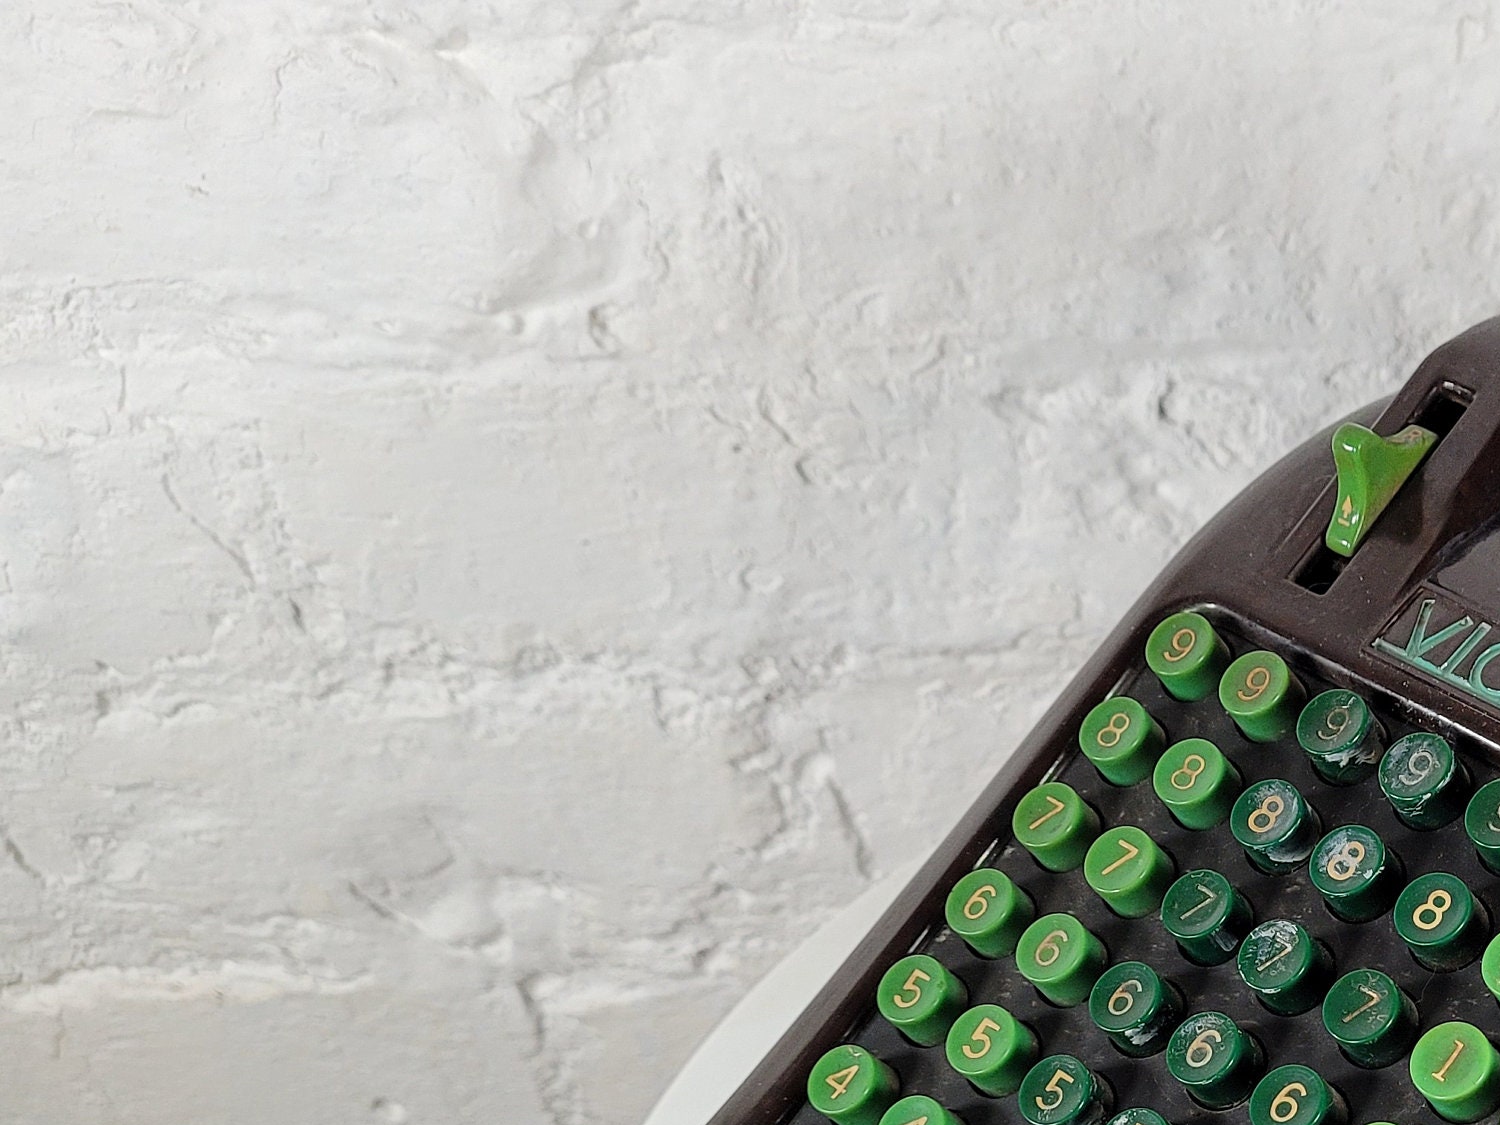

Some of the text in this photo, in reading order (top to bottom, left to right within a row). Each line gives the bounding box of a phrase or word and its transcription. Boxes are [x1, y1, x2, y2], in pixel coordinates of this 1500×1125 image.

[1163, 628, 1195, 663] 9
[1237, 666, 1271, 701] 9
[1097, 713, 1131, 747] 8
[1317, 708, 1349, 740] 9
[1171, 754, 1205, 790] 8
[1398, 751, 1433, 785] 9
[1029, 795, 1065, 830] 7
[1248, 795, 1284, 833] 8
[1101, 839, 1139, 876] 7
[1326, 841, 1365, 881] 8
[963, 884, 997, 920] 6
[1179, 884, 1218, 920] 7
[1413, 889, 1452, 930] 8
[1034, 929, 1068, 967] 6
[1256, 935, 1294, 972] 7
[893, 968, 931, 1009] 5
[1107, 979, 1143, 1016] 6
[1341, 984, 1382, 1023] 7
[962, 1017, 1001, 1059] 5
[1185, 1029, 1222, 1068] 6
[1431, 1039, 1464, 1082] 1
[825, 1064, 860, 1100] 4
[1035, 1069, 1075, 1112] 5
[1269, 1082, 1307, 1123] 6
